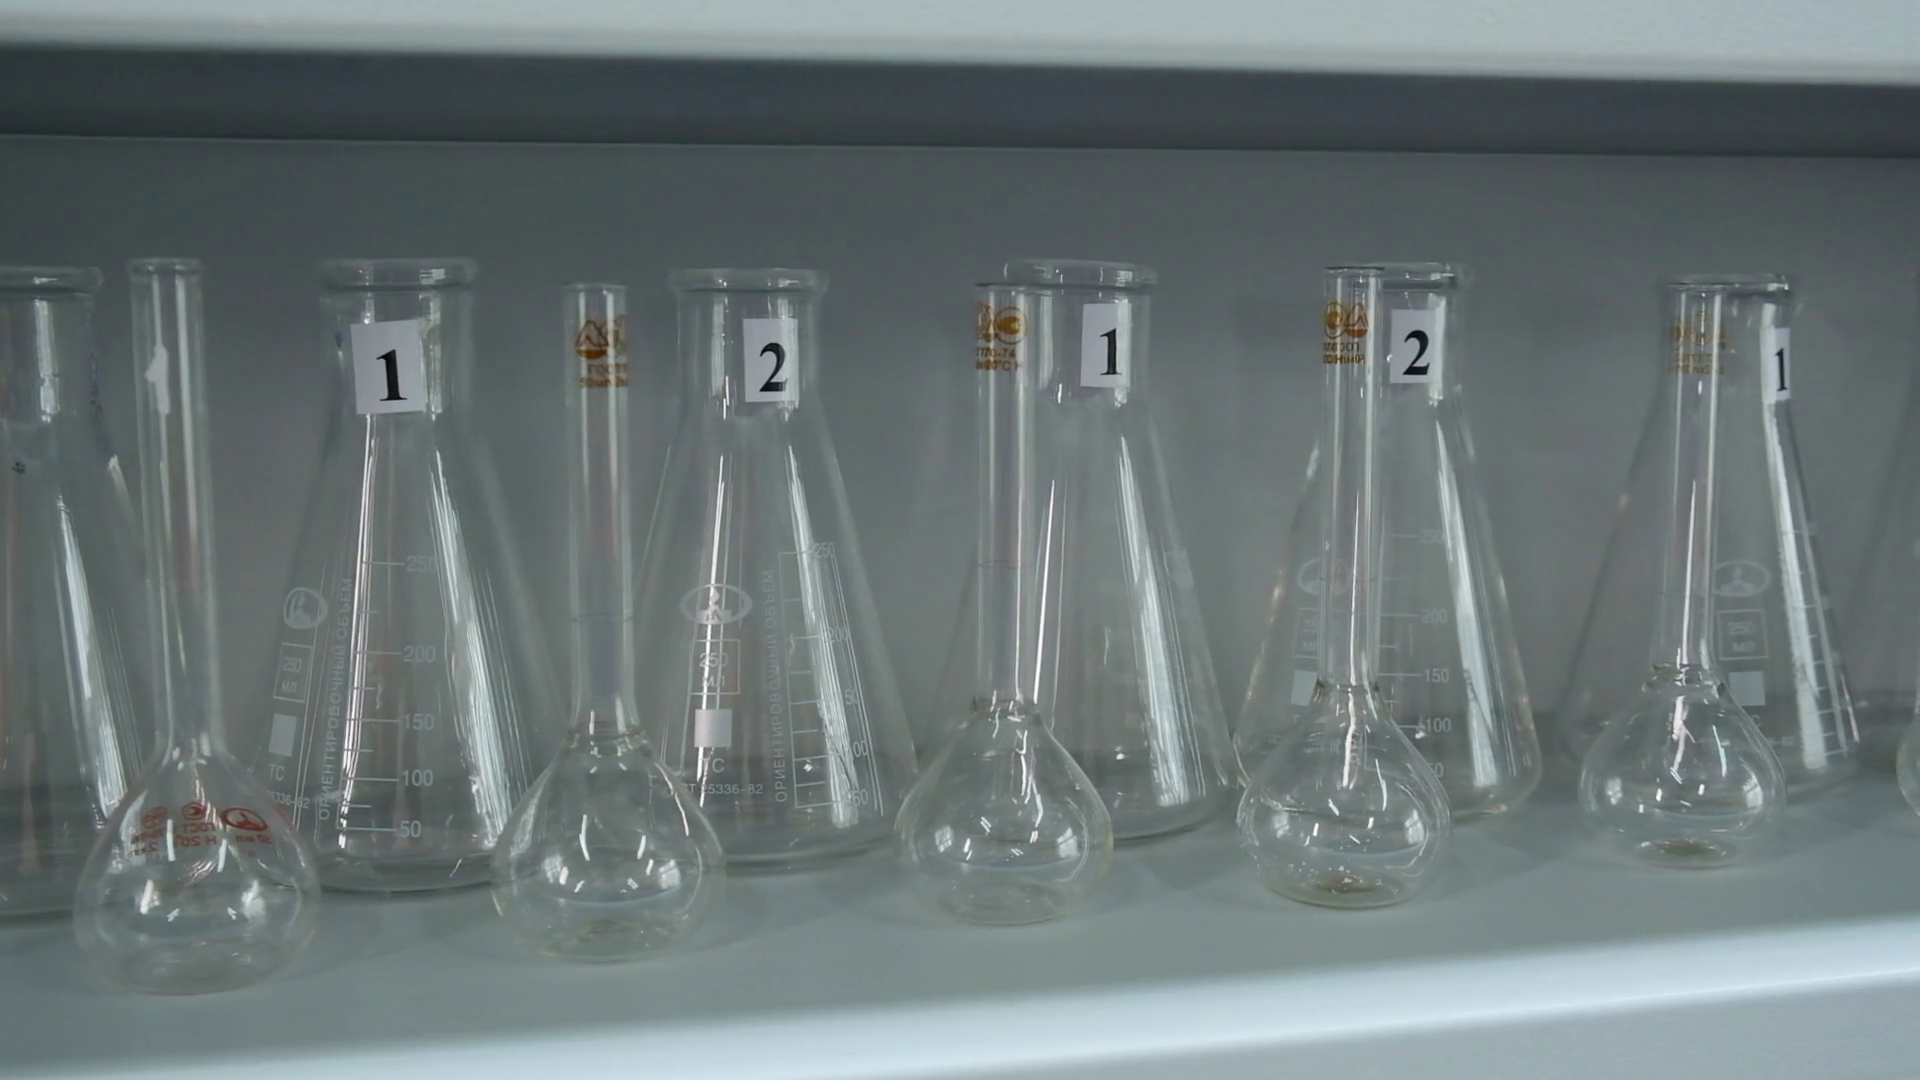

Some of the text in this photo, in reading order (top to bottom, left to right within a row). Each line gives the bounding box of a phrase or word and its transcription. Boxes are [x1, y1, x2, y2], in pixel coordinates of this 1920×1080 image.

[1100, 328, 1122, 376] 1
[1402, 330, 1430, 376] 2
[376, 349, 408, 401] 1
[759, 342, 788, 392] 2
[1775, 348, 1788, 391] 1
[1421, 609, 1448, 623] 200
[403, 645, 436, 662] 200
[699, 653, 728, 668] 250
[282, 656, 302, 674] 250
[1424, 668, 1449, 683] 150
[403, 713, 434, 730] 150
[1425, 718, 1451, 732] 100
[402, 769, 433, 787] 100
[400, 820, 422, 838] 50
